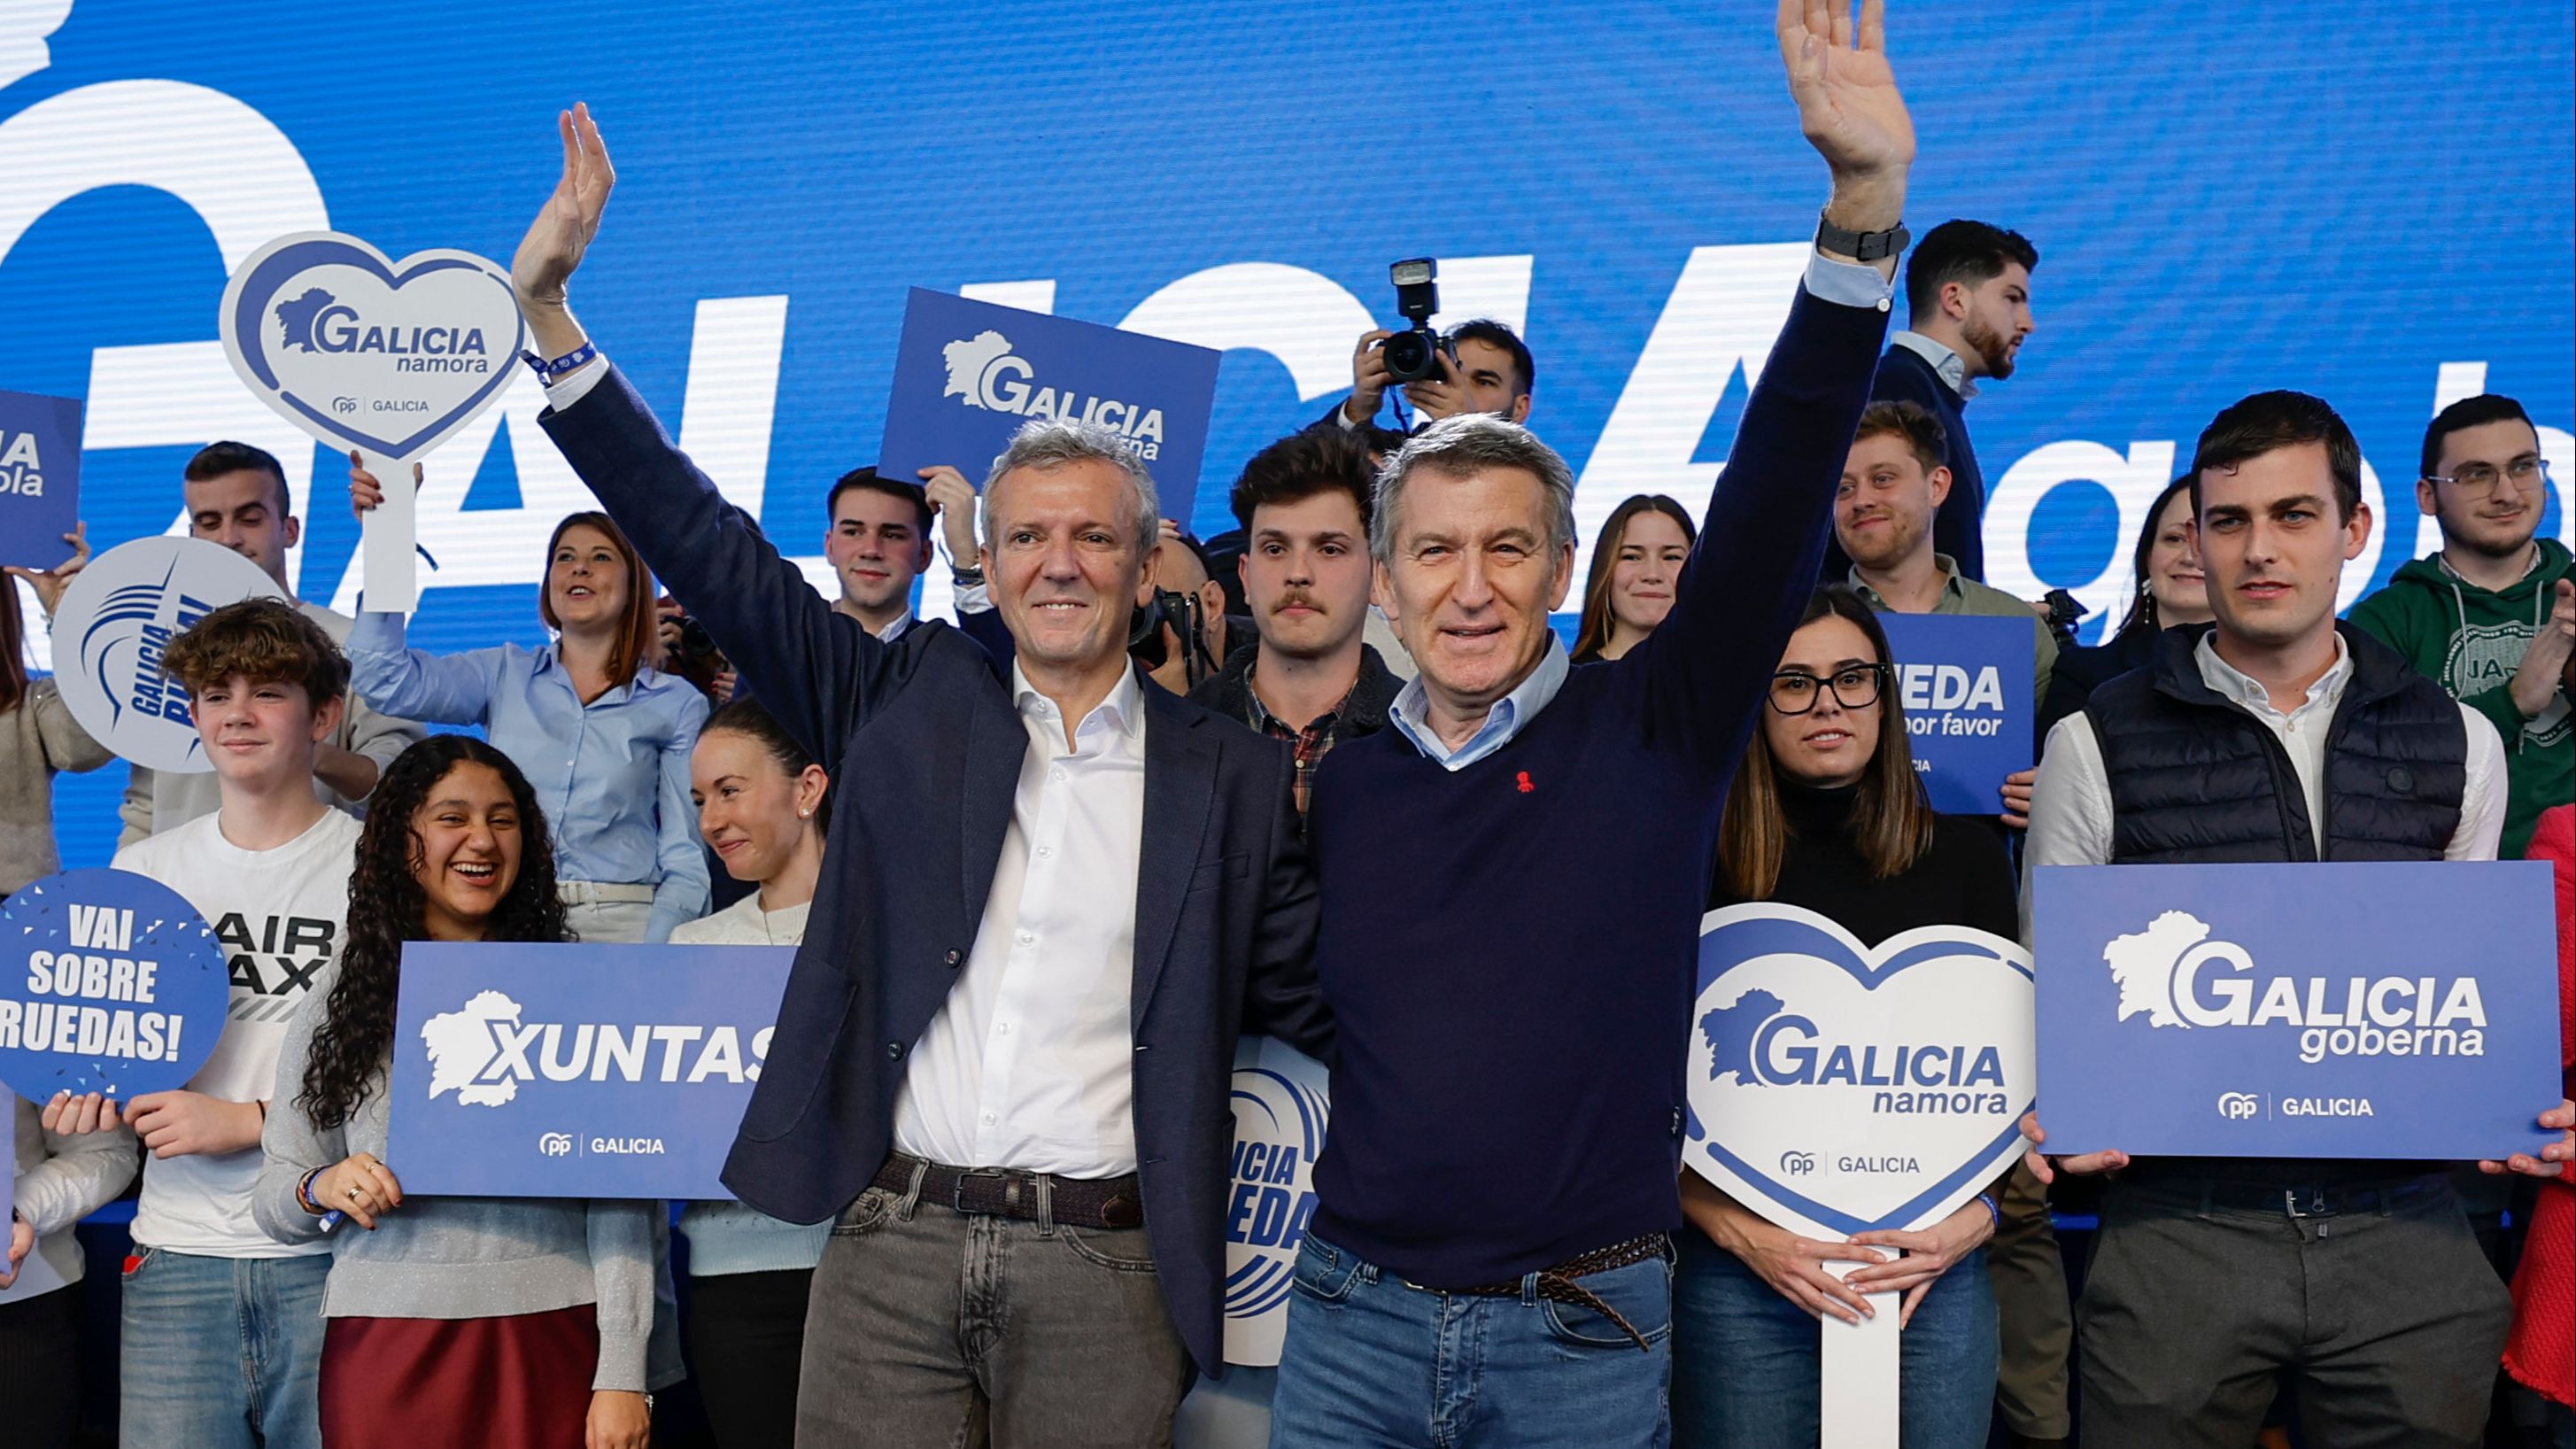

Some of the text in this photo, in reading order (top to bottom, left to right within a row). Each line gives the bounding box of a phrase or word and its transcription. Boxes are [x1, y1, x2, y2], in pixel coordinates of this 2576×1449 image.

[314, 306, 486, 354] GALICIA
[396, 357, 489, 373] namora
[373, 400, 429, 412] GALICIA
[980, 355, 1163, 443] GALICIA
[1892, 663, 2004, 710] EDA
[1942, 712, 2002, 736] favor
[68, 904, 134, 951] VAI
[213, 912, 335, 957] AIR
[27, 950, 158, 1003] SOBRE
[228, 954, 329, 996] AX
[2172, 940, 2487, 1027] GALICIA
[0, 999, 183, 1063] RUEDAS!
[1754, 1014, 2005, 1088] GALICIA
[2299, 1020, 2485, 1063] goberna
[1873, 1091, 2007, 1114] namora
[2282, 1097, 2373, 1117] GALICIA
[591, 1137, 665, 1154] GALICIA
[1838, 1156, 1920, 1174] GALICIA
